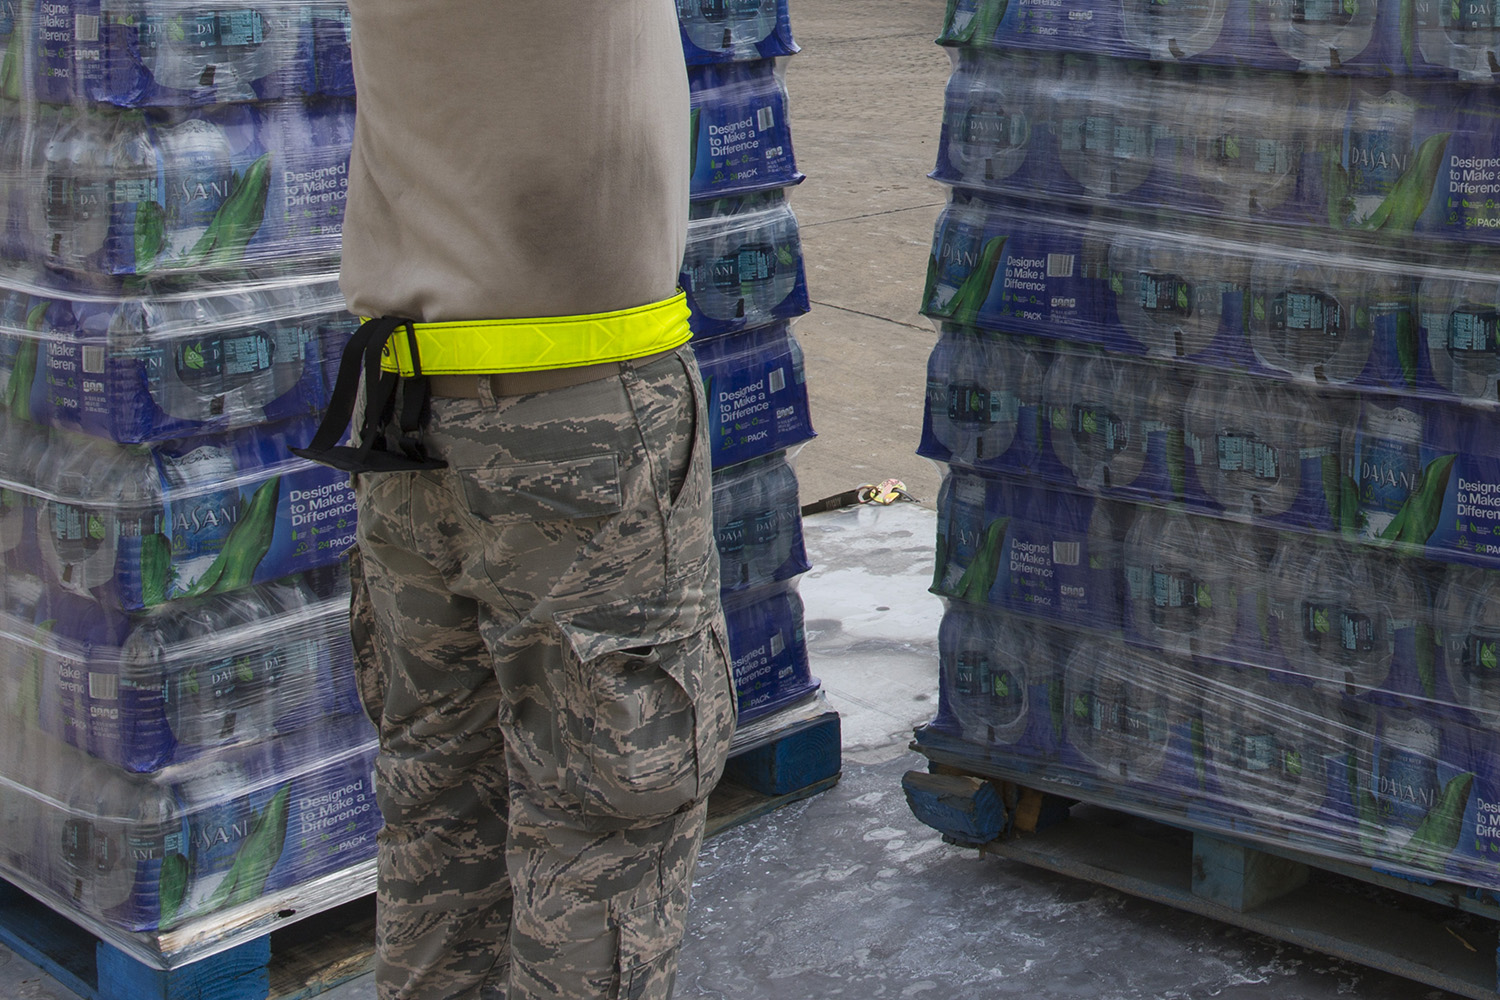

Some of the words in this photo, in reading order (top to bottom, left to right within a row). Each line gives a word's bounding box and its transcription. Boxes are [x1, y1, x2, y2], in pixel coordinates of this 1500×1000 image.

[709, 116, 753, 135] Designed
[709, 137, 722, 147] to
[723, 131, 747, 145] Make
[748, 130, 756, 138] a
[711, 140, 759, 157] Difference
[1351, 144, 1408, 172] DASANI
[284, 161, 347, 184] Designed
[730, 168, 758, 181] 24PACK
[1449, 171, 1461, 181] to
[1462, 169, 1495, 182] Make
[169, 177, 229, 207] ASANI
[284, 185, 299, 195] to
[303, 178, 337, 193] Make
[1006, 255, 1046, 268] Designed
[1005, 268, 1014, 278] to
[1013, 268, 1039, 280] Make
[1004, 277, 1047, 292] Difference
[1015, 309, 1042, 320] 24PACK
[719, 379, 764, 402] Designed
[720, 403, 731, 413] to
[733, 396, 757, 410] Make
[758, 391, 765, 400] a
[721, 402, 769, 424] Difference
[740, 429, 768, 445] 24PACK
[1362, 461, 1416, 491] DASANI
[290, 504, 306, 515] to
[309, 494, 344, 511] Make
[347, 490, 356, 501] a
[1457, 492, 1468, 503] to
[1010, 549, 1019, 561] to
[1019, 552, 1046, 566] Make
[1010, 560, 1054, 578] Difference
[732, 645, 766, 669] esigned
[735, 660, 761, 678] Make
[760, 656, 768, 666] a
[300, 779, 363, 811] Designed
[300, 811, 316, 823] to
[319, 796, 354, 818] Make
[356, 793, 366, 803] a
[301, 803, 371, 833] Difference
[1476, 812, 1487, 823] to
